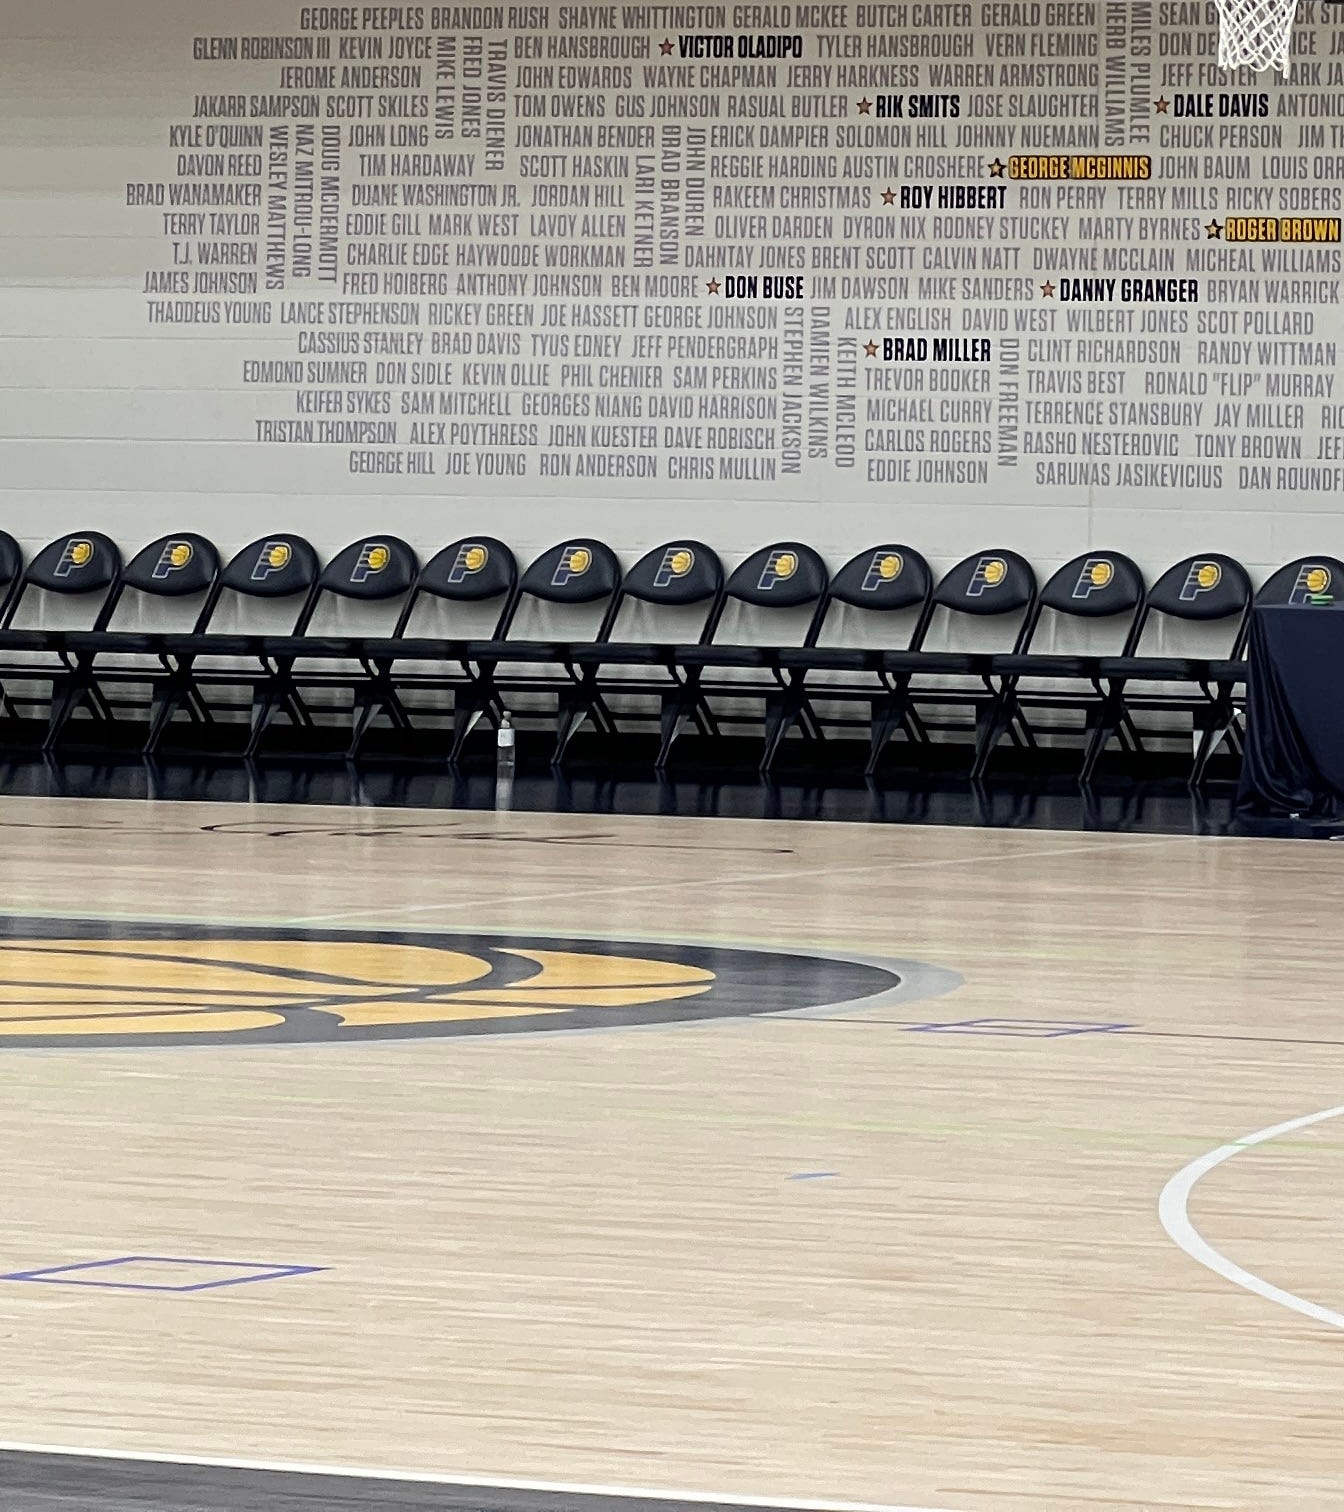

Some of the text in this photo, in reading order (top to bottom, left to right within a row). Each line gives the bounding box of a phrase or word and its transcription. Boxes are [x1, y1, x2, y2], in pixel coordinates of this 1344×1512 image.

[732, 5, 848, 28] GERALD MCKEE
[339, 36, 433, 59] KEVIN JOYCE
[678, 35, 803, 58] VICTOR OLADIPO
[815, 34, 974, 58] TYLER HANSBROUGH
[875, 95, 960, 117] RIK SMITS
[1173, 94, 1269, 117] DALE DAVIS
[169, 125, 264, 147] KYLE O'QUINN
[1159, 125, 1282, 148] CHUCK PERSON
[710, 156, 838, 178] REGGIE HARDING
[1008, 156, 1150, 180] GEORGE MCGINNIS
[900, 186, 1009, 208] ROY HIBBERT
[1225, 219, 1340, 242] ROGER BROWN
[143, 272, 258, 294] JAMES JOHNSON
[725, 276, 804, 299] DON BUSE
[1060, 279, 1199, 302] DANNY GRANGER
[644, 306, 778, 329] GEORGE JOHNSON
[883, 338, 991, 361] BRAD MILLER
[243, 361, 368, 383] EDMOND SUMNER
[254, 420, 397, 443] TRISTAN THOMPSON
[668, 456, 776, 480] CHRIS MULLIN
